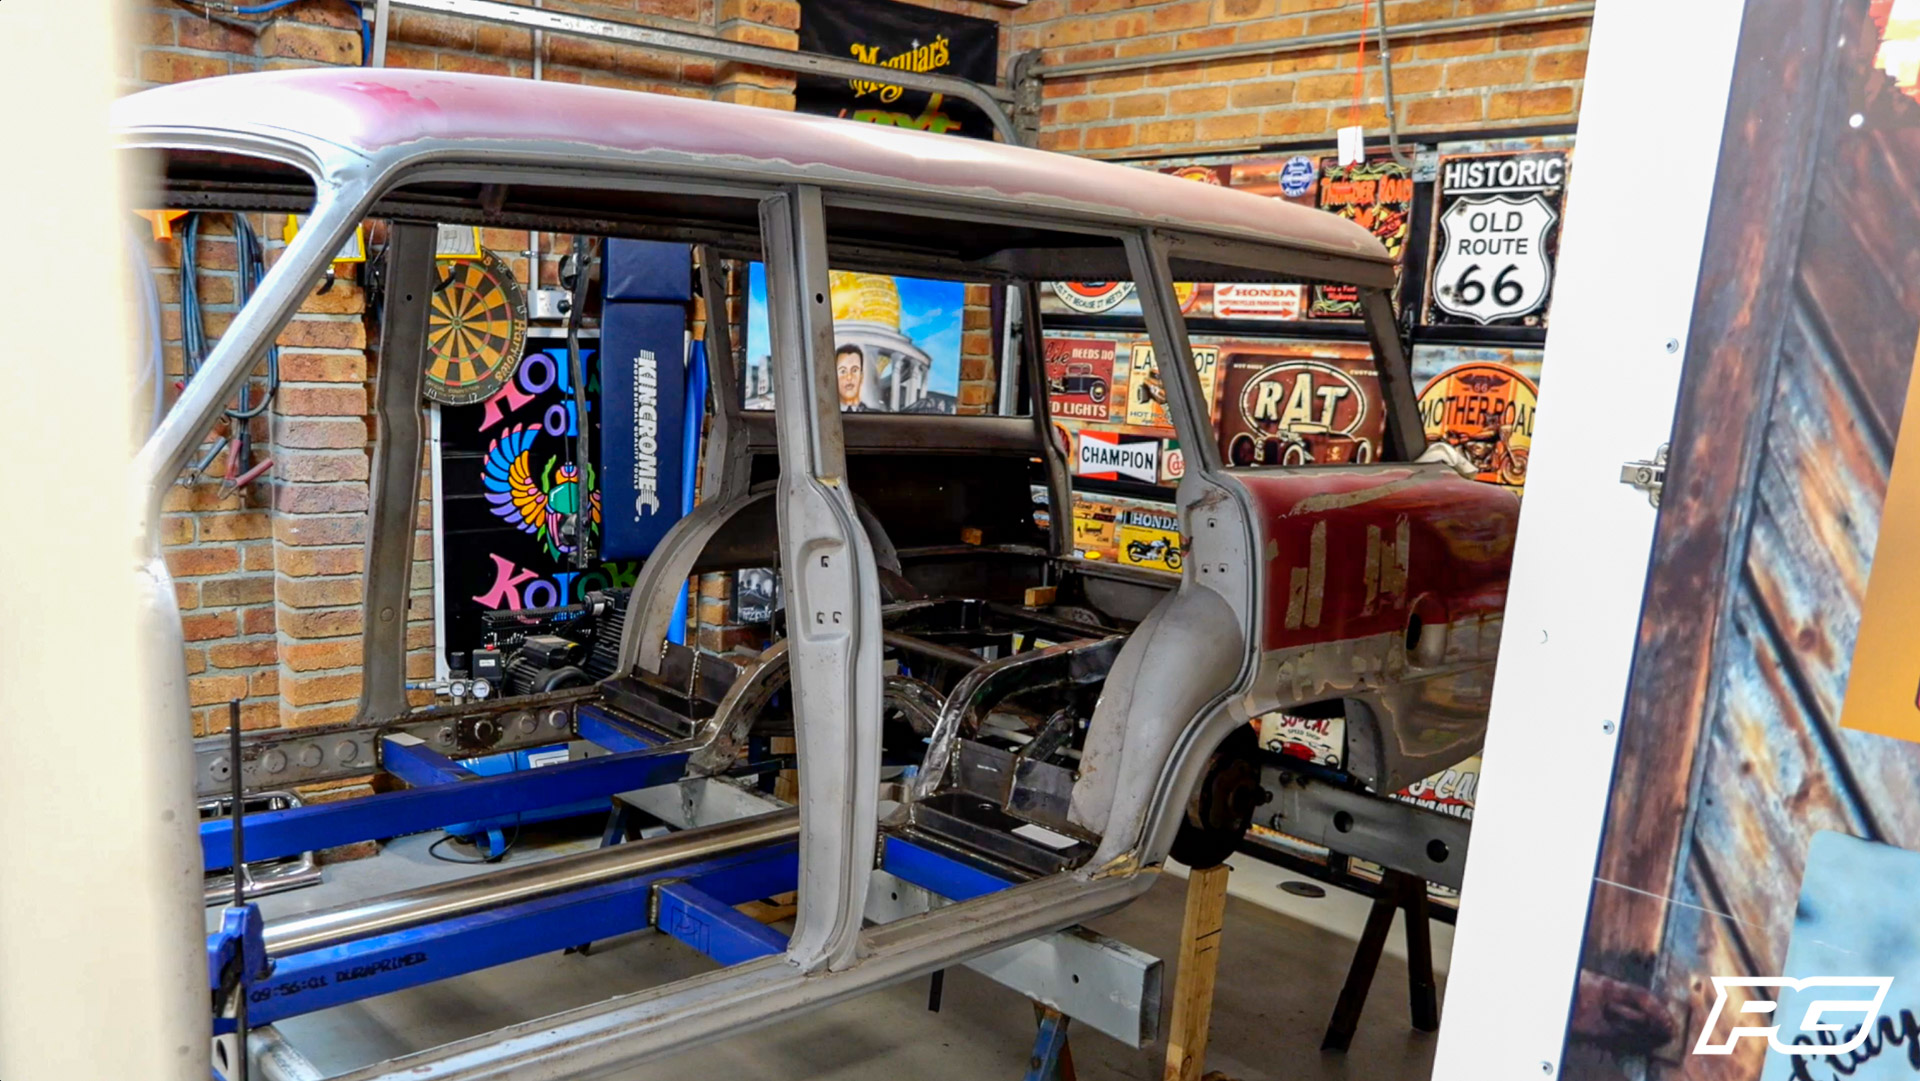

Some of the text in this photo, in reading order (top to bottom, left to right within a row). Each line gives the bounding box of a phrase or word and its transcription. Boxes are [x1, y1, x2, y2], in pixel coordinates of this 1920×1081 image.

[1444, 158, 1562, 189] HISTORIC
[1469, 211, 1523, 233] OLD
[1458, 238, 1528, 255] ROUTE
[1235, 288, 1297, 297] HONDA
[1456, 264, 1524, 307] 66
[494, 319, 526, 382] Harrows
[1063, 402, 1107, 418] LIGHTS
[1254, 372, 1349, 431] RAT
[1420, 395, 1490, 428] MOTHER
[638, 357, 657, 491] KINCROME
[1081, 445, 1154, 470] CHAMPION
[1132, 512, 1180, 531] HONDA
